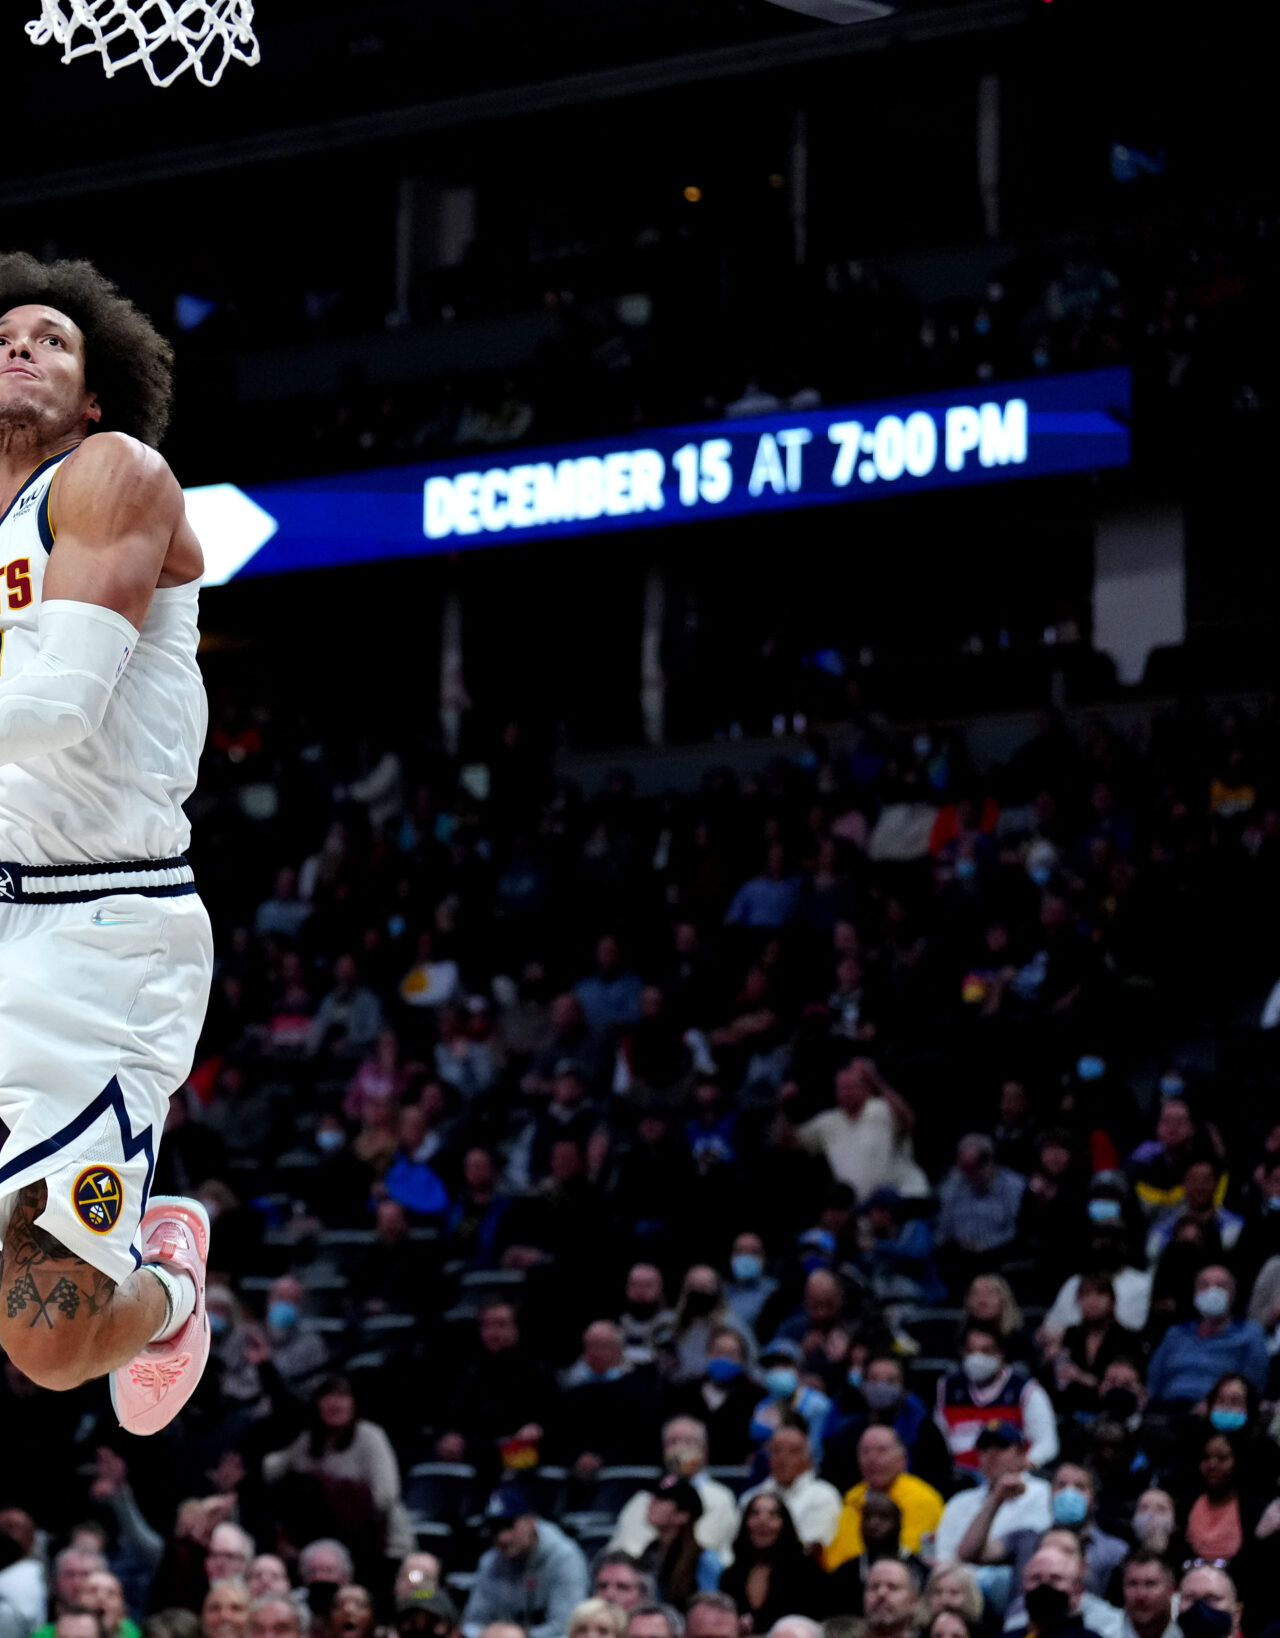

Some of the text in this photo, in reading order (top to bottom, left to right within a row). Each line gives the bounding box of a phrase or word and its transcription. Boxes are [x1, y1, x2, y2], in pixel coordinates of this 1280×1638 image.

[423, 398, 1028, 539] DECEMBER 15 AT 7:00 PM
